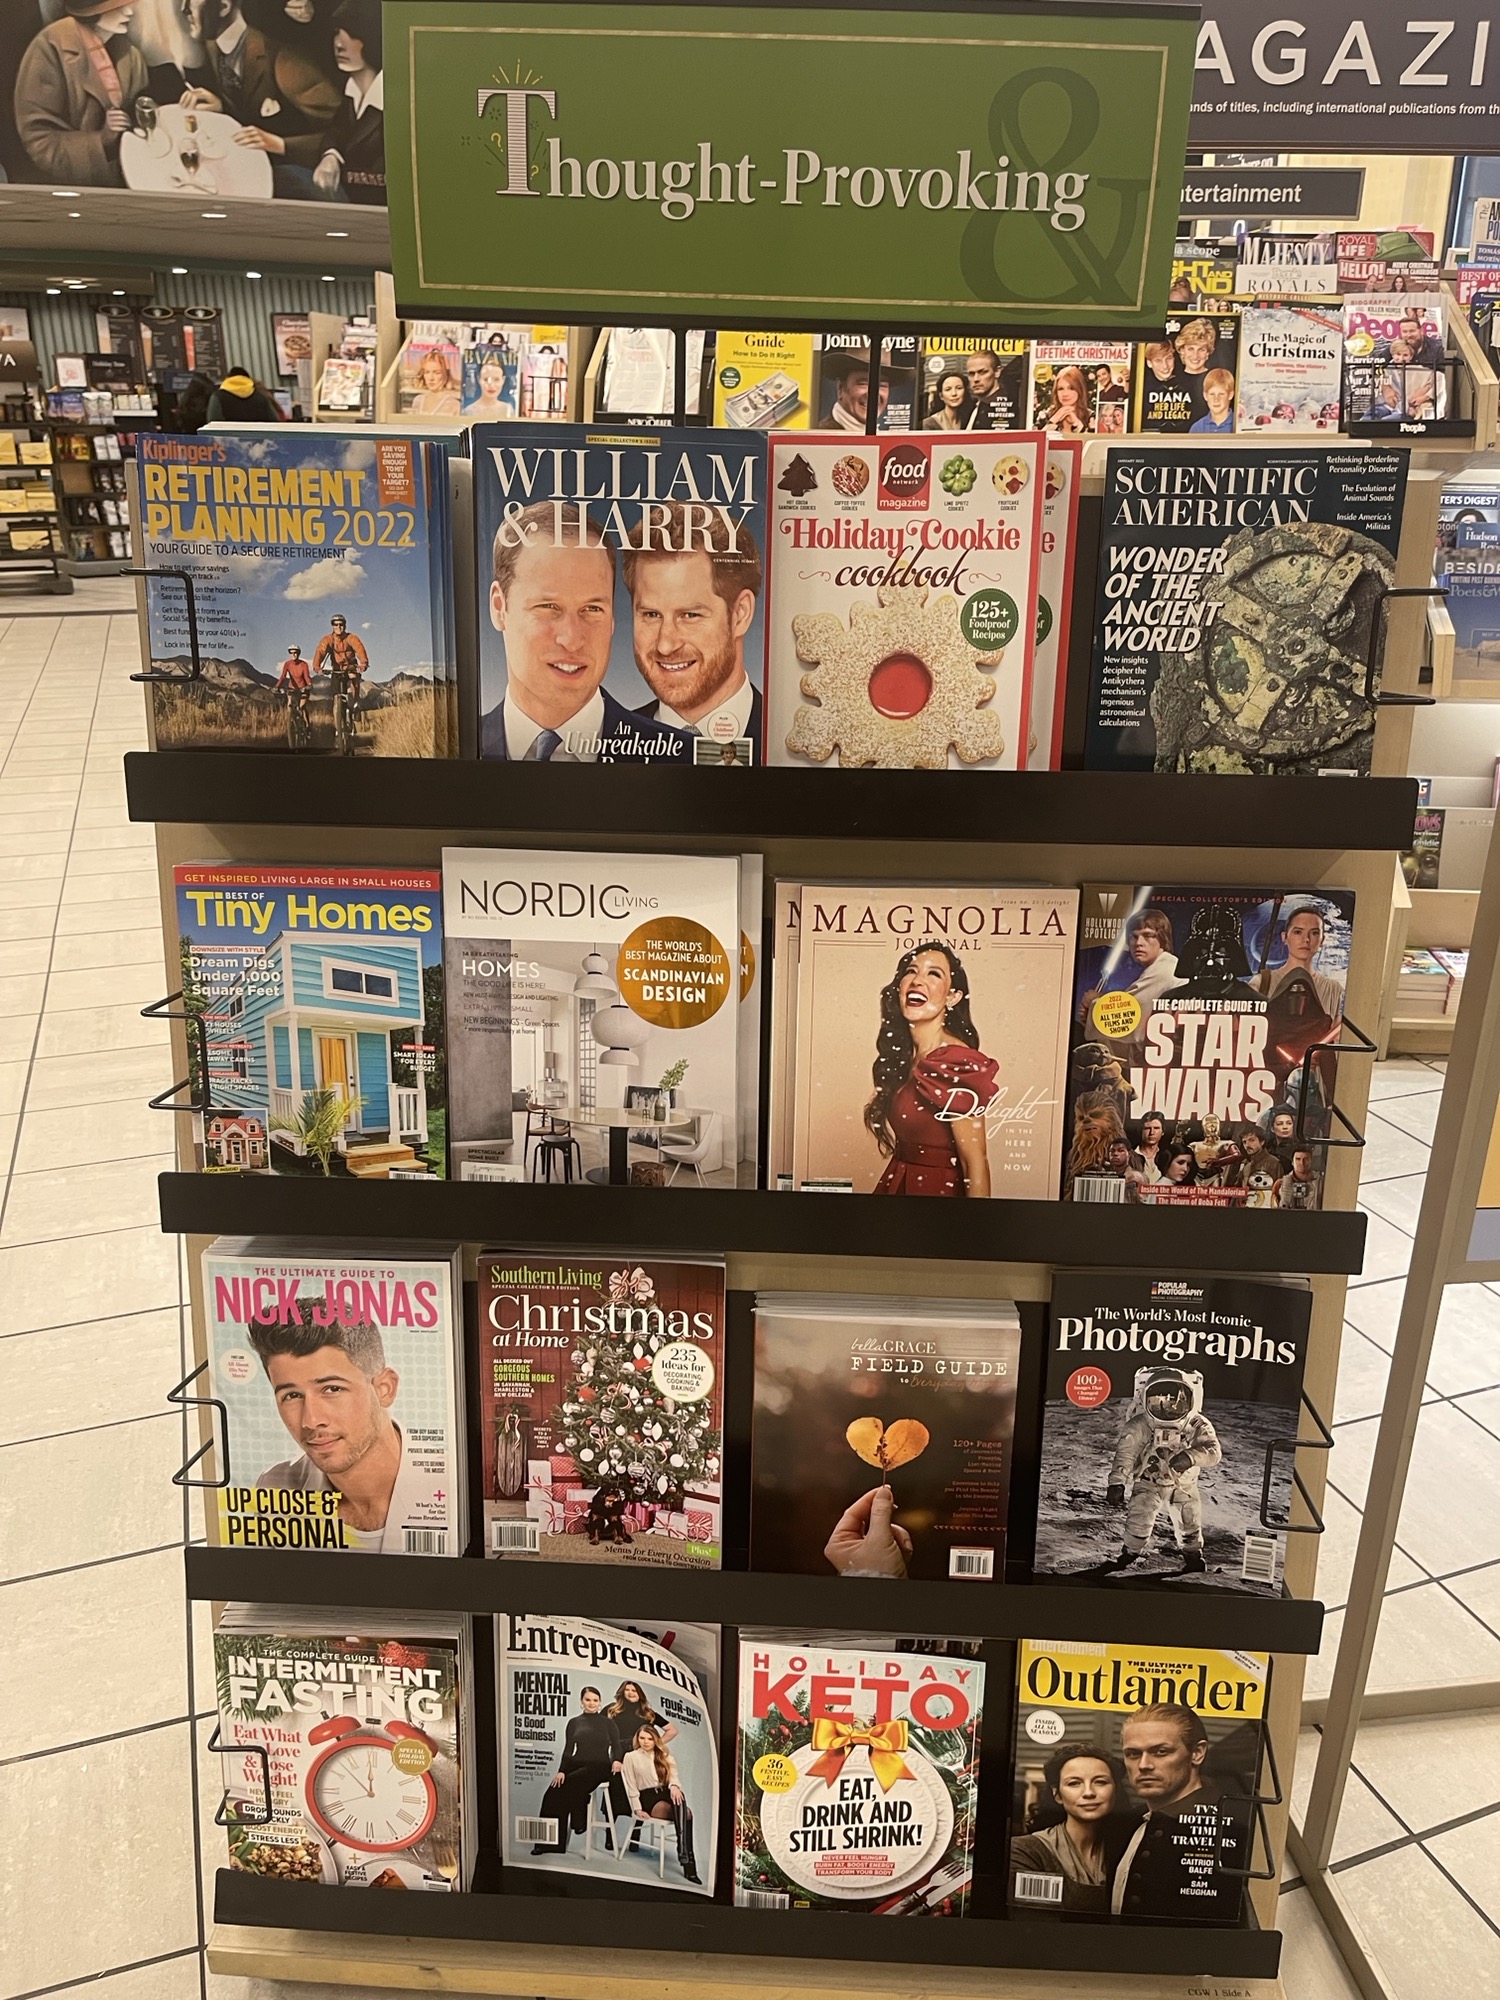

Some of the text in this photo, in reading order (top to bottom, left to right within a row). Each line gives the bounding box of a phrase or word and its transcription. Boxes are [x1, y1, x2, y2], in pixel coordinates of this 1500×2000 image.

[1195, 20, 1490, 85] AGAZI
[1216, 102, 1226, 113] of
[1230, 102, 1259, 114] titles,
[1263, 103, 1313, 115] including
[1316, 103, 1385, 114] international
[1389, 103, 1455, 115] publications
[1459, 103, 1485, 115] from
[476, 88, 1089, 232] Thought-Provoking
[1186, 247, 1220, 257] scope
[1243, 237, 1330, 265] MAJESTY
[1338, 236, 1374, 245] ROYAL
[1339, 245, 1365, 257] LIFE
[1340, 262, 1384, 280] HELLO!
[1461, 271, 1487, 281] BEST
[1248, 280, 1326, 292] ROYALS
[744, 335, 785, 348] Guide
[825, 334, 861, 350] John
[1259, 333, 1326, 346] The Magic of
[733, 350, 748, 358] How
[1035, 347, 1128, 360] LIFETIME CHRISTMAS
[1249, 343, 1335, 360] Christmas
[1149, 392, 1191, 403] DIANA
[1154, 402, 1185, 411] HER LIFE
[1148, 411, 1191, 420] AND LEGACY
[1400, 424, 1426, 434] People
[142, 440, 227, 464] Kiplinger's
[1326, 455, 1362, 465] Rethinking
[487, 448, 759, 504] WILLIAM
[882, 456, 927, 486] food
[1115, 467, 1318, 495] SCIENTIFIC
[1329, 465, 1366, 474] Personality
[145, 465, 365, 507] RETIREMENT
[382, 478, 409, 486] TARGET?
[879, 498, 927, 509] magazine
[1112, 499, 1313, 526] AMERICAN
[1464, 497, 1497, 506] DIGEST
[147, 503, 416, 547] PLANNING 2022
[500, 500, 753, 553] & HARRY
[1466, 532, 1497, 541] Hudson
[780, 518, 1020, 559] Holiday Cookie
[150, 543, 347, 558] YOUR GUIDE TO A SECURE RETIREMENT
[1109, 546, 1228, 574] WONDER
[834, 546, 978, 595] cookbook
[1104, 574, 1198, 599] OF THE
[971, 601, 1008, 619] 125+
[1102, 601, 1225, 627] ANCIENT
[969, 618, 1011, 630] Foolproof
[972, 630, 1006, 641] Recipes
[1103, 627, 1201, 652] WORLD
[1103, 666, 1146, 676] decipher the
[1104, 656, 1149, 665] New insights
[614, 721, 631, 735] An
[563, 730, 684, 757] Unbreakable
[251, 892, 264, 900] OF
[460, 879, 659, 919] NORDIC LIVING
[186, 891, 432, 933] Tiny Homes
[812, 905, 1067, 936] MAGNOLIA
[624, 969, 724, 985] SCANDINAVIAN
[642, 985, 706, 1004] DESIGN
[1152, 999, 1267, 1013] THE COMPLETE GUIDE TO
[1145, 1013, 1269, 1068] STAR
[1130, 1068, 1276, 1122] WARS
[934, 1086, 1059, 1138] Delight
[491, 1265, 602, 1290] Southern Living
[215, 1276, 438, 1328] NICK JONAS
[488, 1294, 714, 1339] Christmas
[1095, 1307, 1251, 1327] The World's Most Iconic
[493, 1333, 569, 1348] at Home
[1056, 1317, 1296, 1366] Photographs
[670, 1348, 697, 1362] 235
[851, 1357, 1008, 1375] FIELD GUIDE
[226, 1488, 336, 1516] UP CLOSE &
[228, 1515, 349, 1550] PERSONAL
[506, 1614, 700, 1699] Entrepreneur
[228, 1656, 441, 1688] INTERMITTENT
[753, 1653, 971, 1684] HOLIDAY
[514, 1671, 571, 1695] MENTAL
[1027, 1656, 1258, 1712] Outlander
[230, 1677, 443, 1722] FASTING
[514, 1694, 567, 1716] HEALTH
[752, 1670, 969, 1731] KETO
[839, 1777, 876, 1801] EAT,
[802, 1801, 912, 1827] DRINK AND
[789, 1824, 922, 1853] STILL SHRINK!
[1180, 1887, 1217, 1897] HEUGHAN
